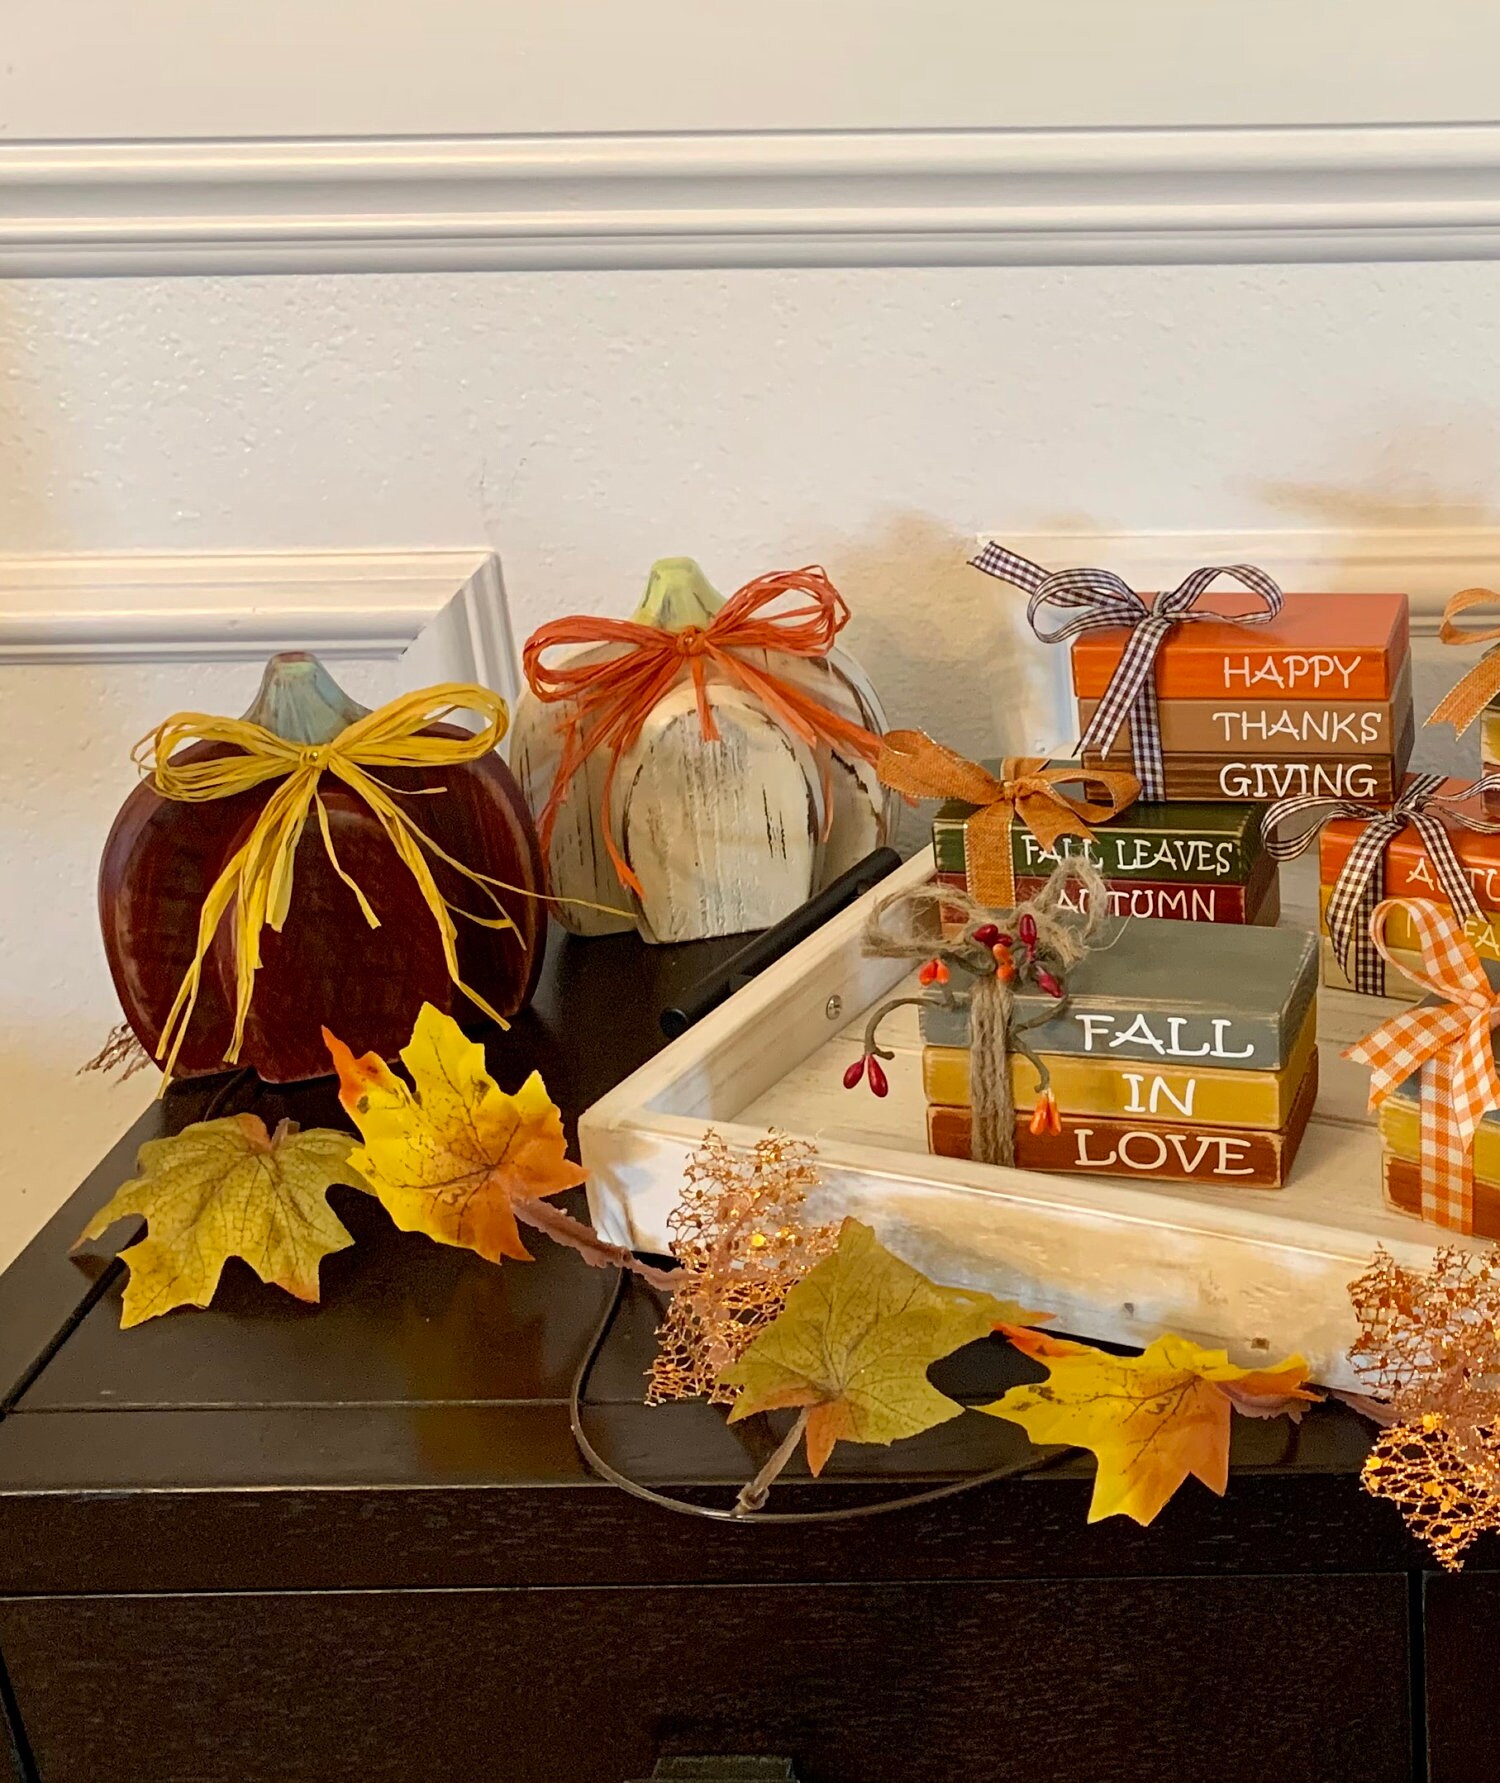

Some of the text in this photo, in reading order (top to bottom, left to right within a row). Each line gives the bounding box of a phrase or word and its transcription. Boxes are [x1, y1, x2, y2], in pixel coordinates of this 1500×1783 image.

[1223, 655, 1362, 689] HAPPY
[1212, 709, 1382, 745] THANKS
[1219, 762, 1378, 798] GIVING
[1116, 839, 1233, 876] LEAVES
[1075, 1013, 1254, 1059] FALL
[1121, 1073, 1196, 1117] IN
[1073, 1128, 1255, 1175] LOVE
